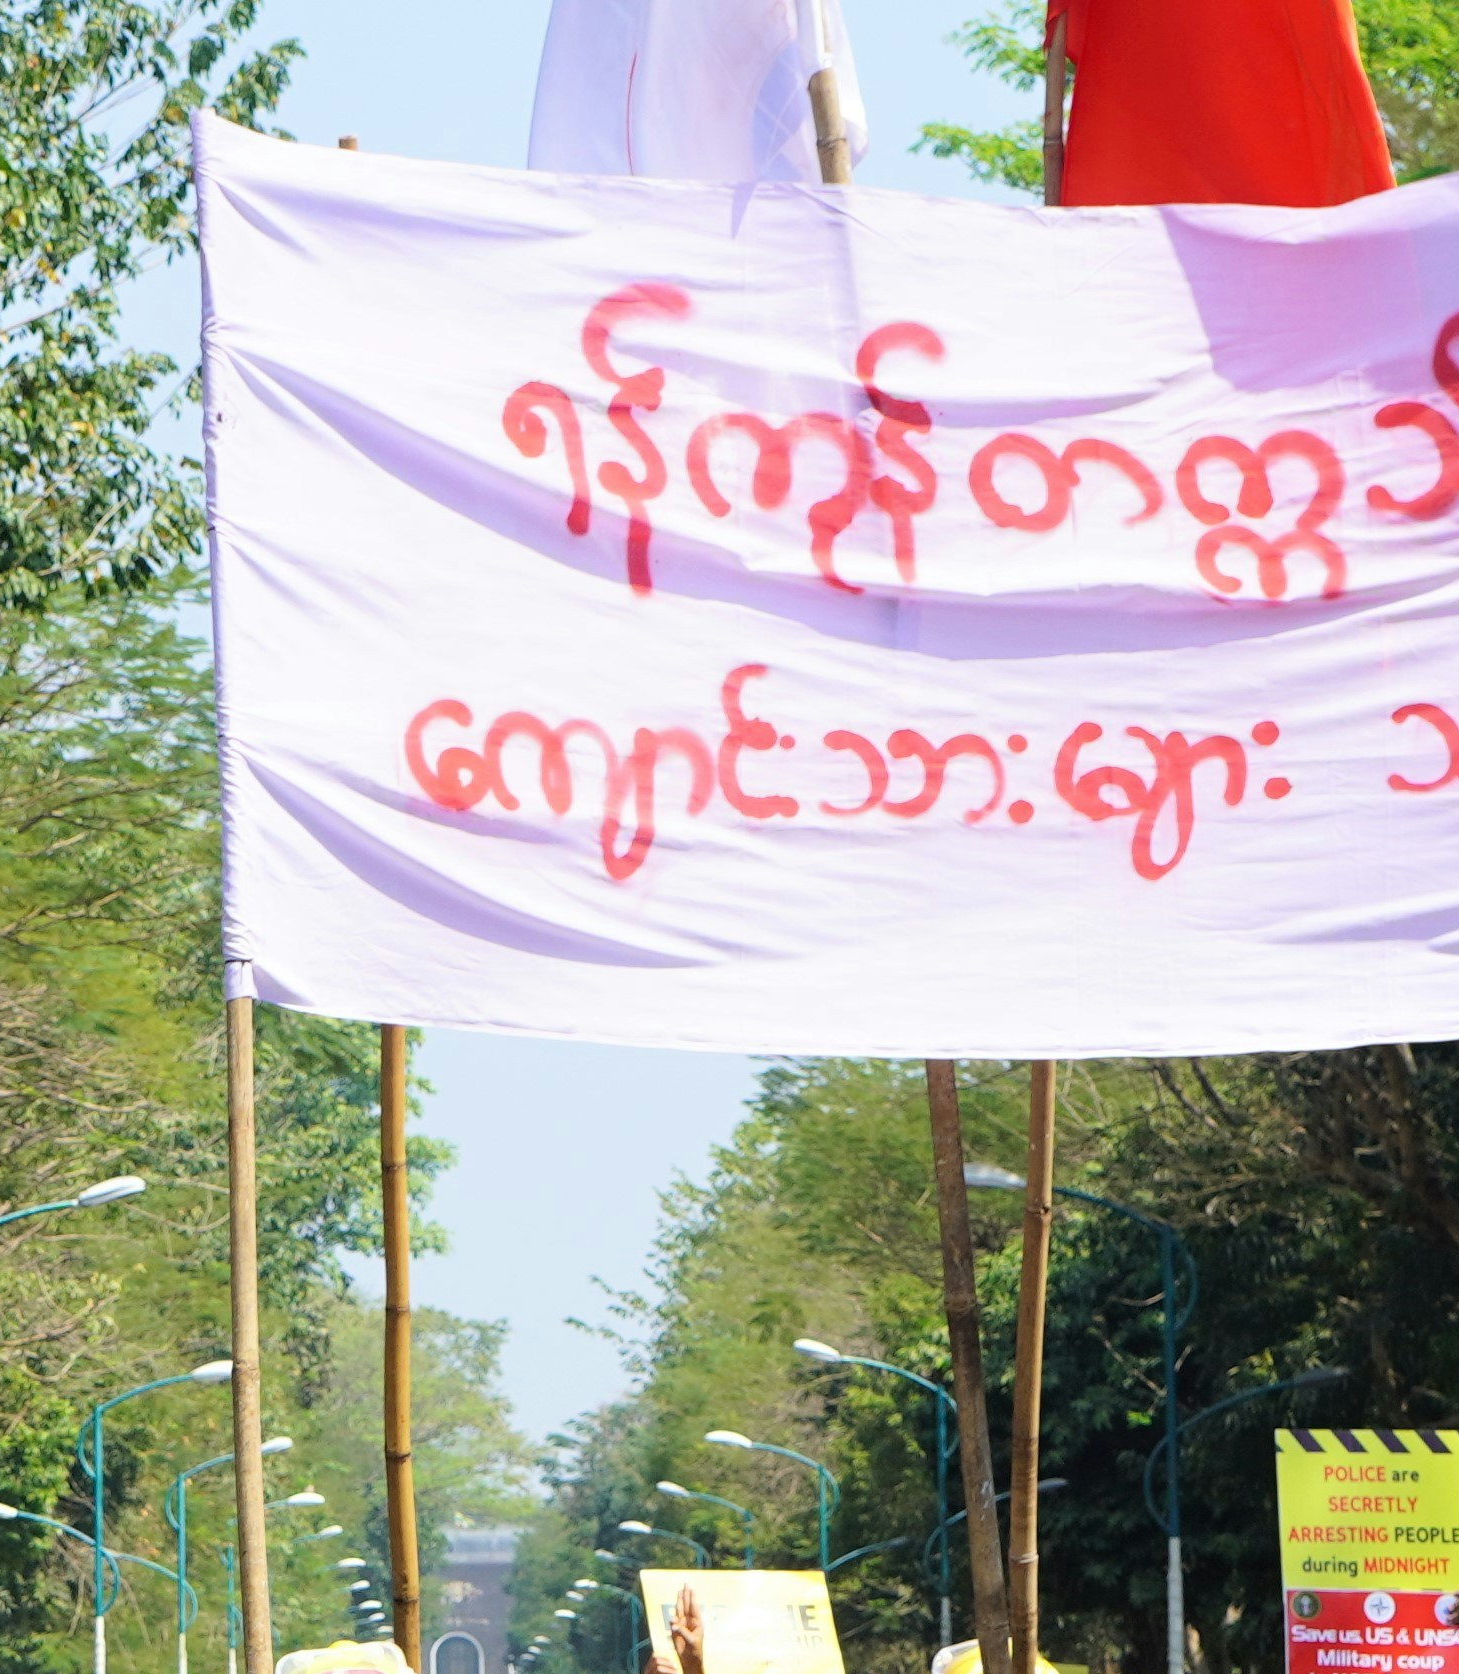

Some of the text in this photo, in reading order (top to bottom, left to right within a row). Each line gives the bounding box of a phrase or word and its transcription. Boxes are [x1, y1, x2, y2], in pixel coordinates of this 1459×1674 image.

[1324, 1466, 1419, 1483] POLICE are
[1328, 1497, 1418, 1512] SECRETLY
[1288, 1527, 1389, 1543] ARRESTING
[1302, 1555, 1450, 1576] during MIDNIGHT
[1291, 1625, 1335, 1643] Save
[1366, 1627, 1393, 1645] US
[1396, 1628, 1411, 1645] &
[1317, 1649, 1445, 1672] Military coup
